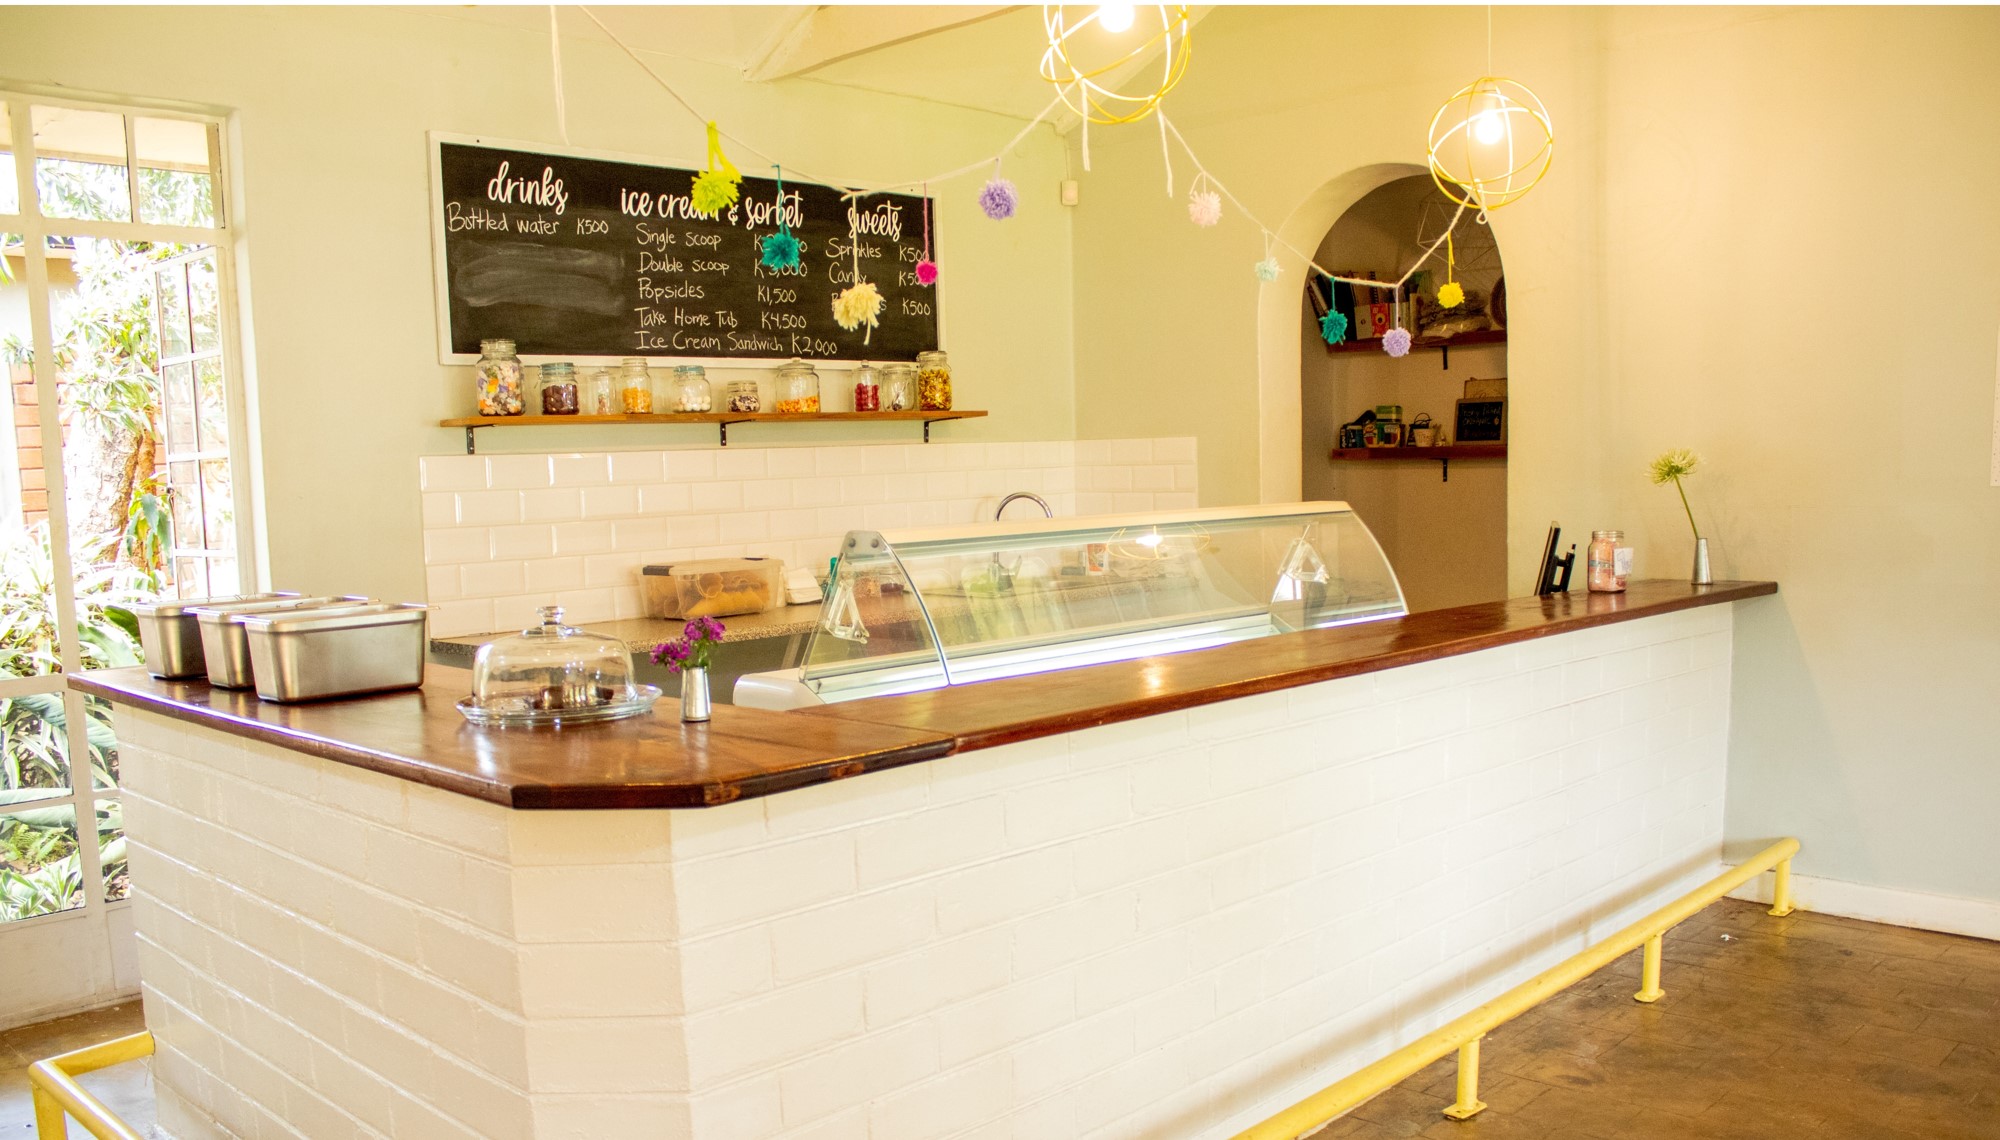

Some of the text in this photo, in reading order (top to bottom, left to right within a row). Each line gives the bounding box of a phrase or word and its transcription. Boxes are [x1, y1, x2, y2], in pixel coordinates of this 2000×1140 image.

[487, 160, 569, 216] drinks
[446, 202, 609, 235] Bottled water K500
[620, 187, 654, 217] ice
[727, 204, 739, 226] &
[745, 189, 804, 231] sorbet
[847, 200, 903, 242] sweets
[635, 223, 676, 252] Single
[636, 252, 684, 274] Double
[637, 277, 797, 306] Popsicles K1,500
[898, 270, 929, 288] K50
[634, 306, 667, 329] Take
[674, 307, 711, 327] Home
[715, 310, 738, 328] Tub
[902, 297, 931, 316] K500
[634, 330, 837, 356] Ice Cream Sandwich K2,000
